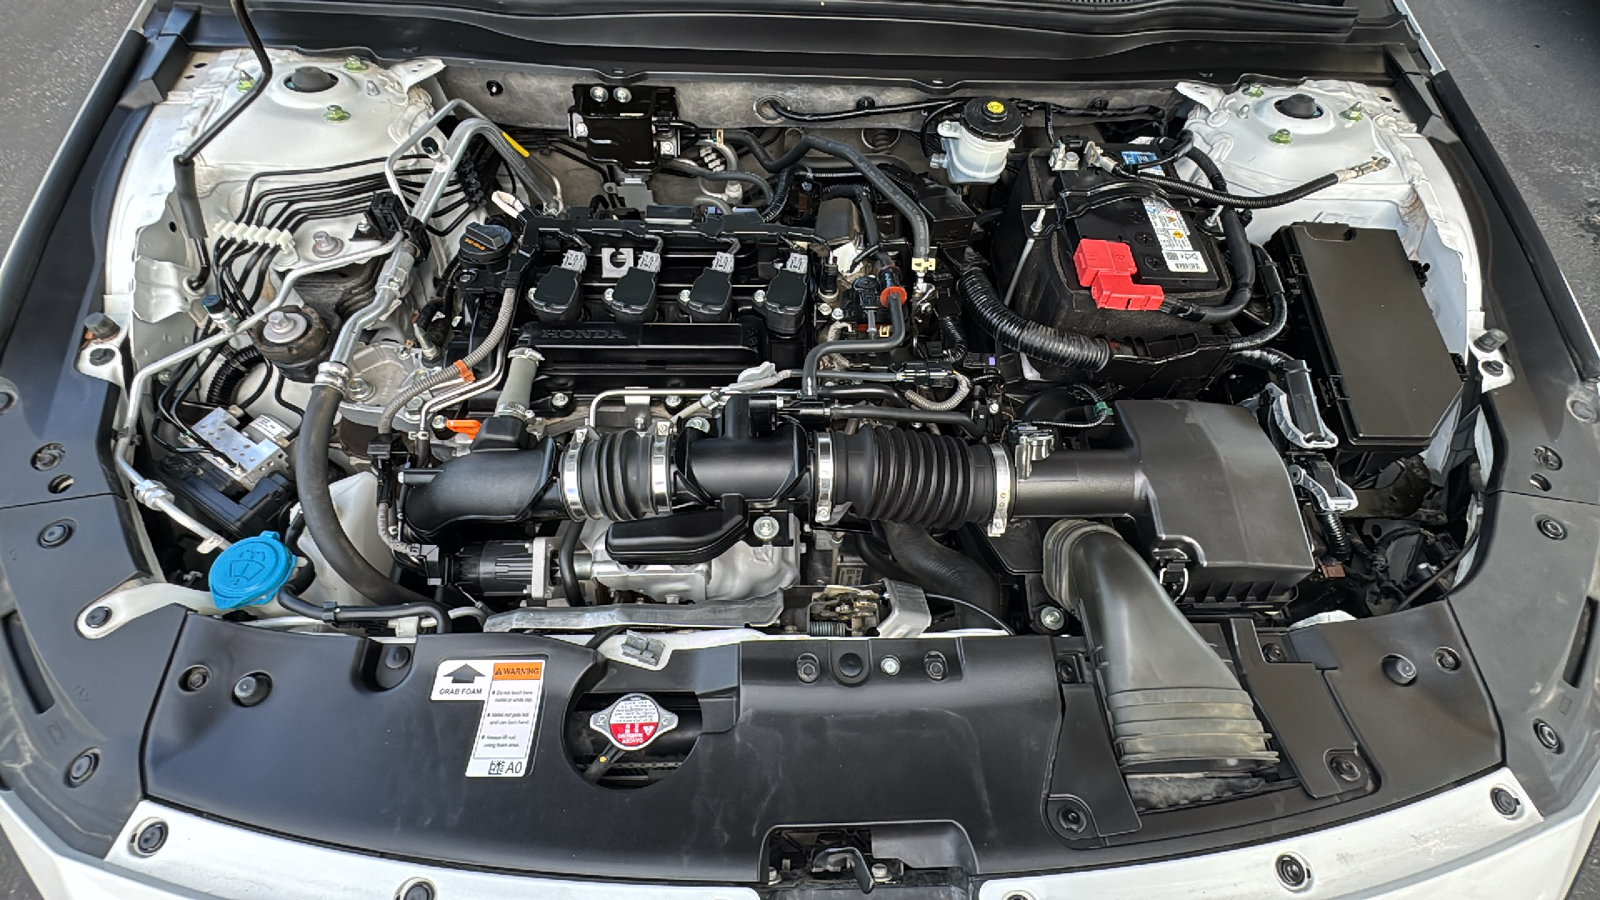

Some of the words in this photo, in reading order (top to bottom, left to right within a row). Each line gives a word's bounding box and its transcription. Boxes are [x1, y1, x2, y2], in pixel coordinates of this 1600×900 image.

[541, 329, 628, 339] HONDA
[503, 667, 539, 675] WARNING
[505, 761, 522, 774] A0
